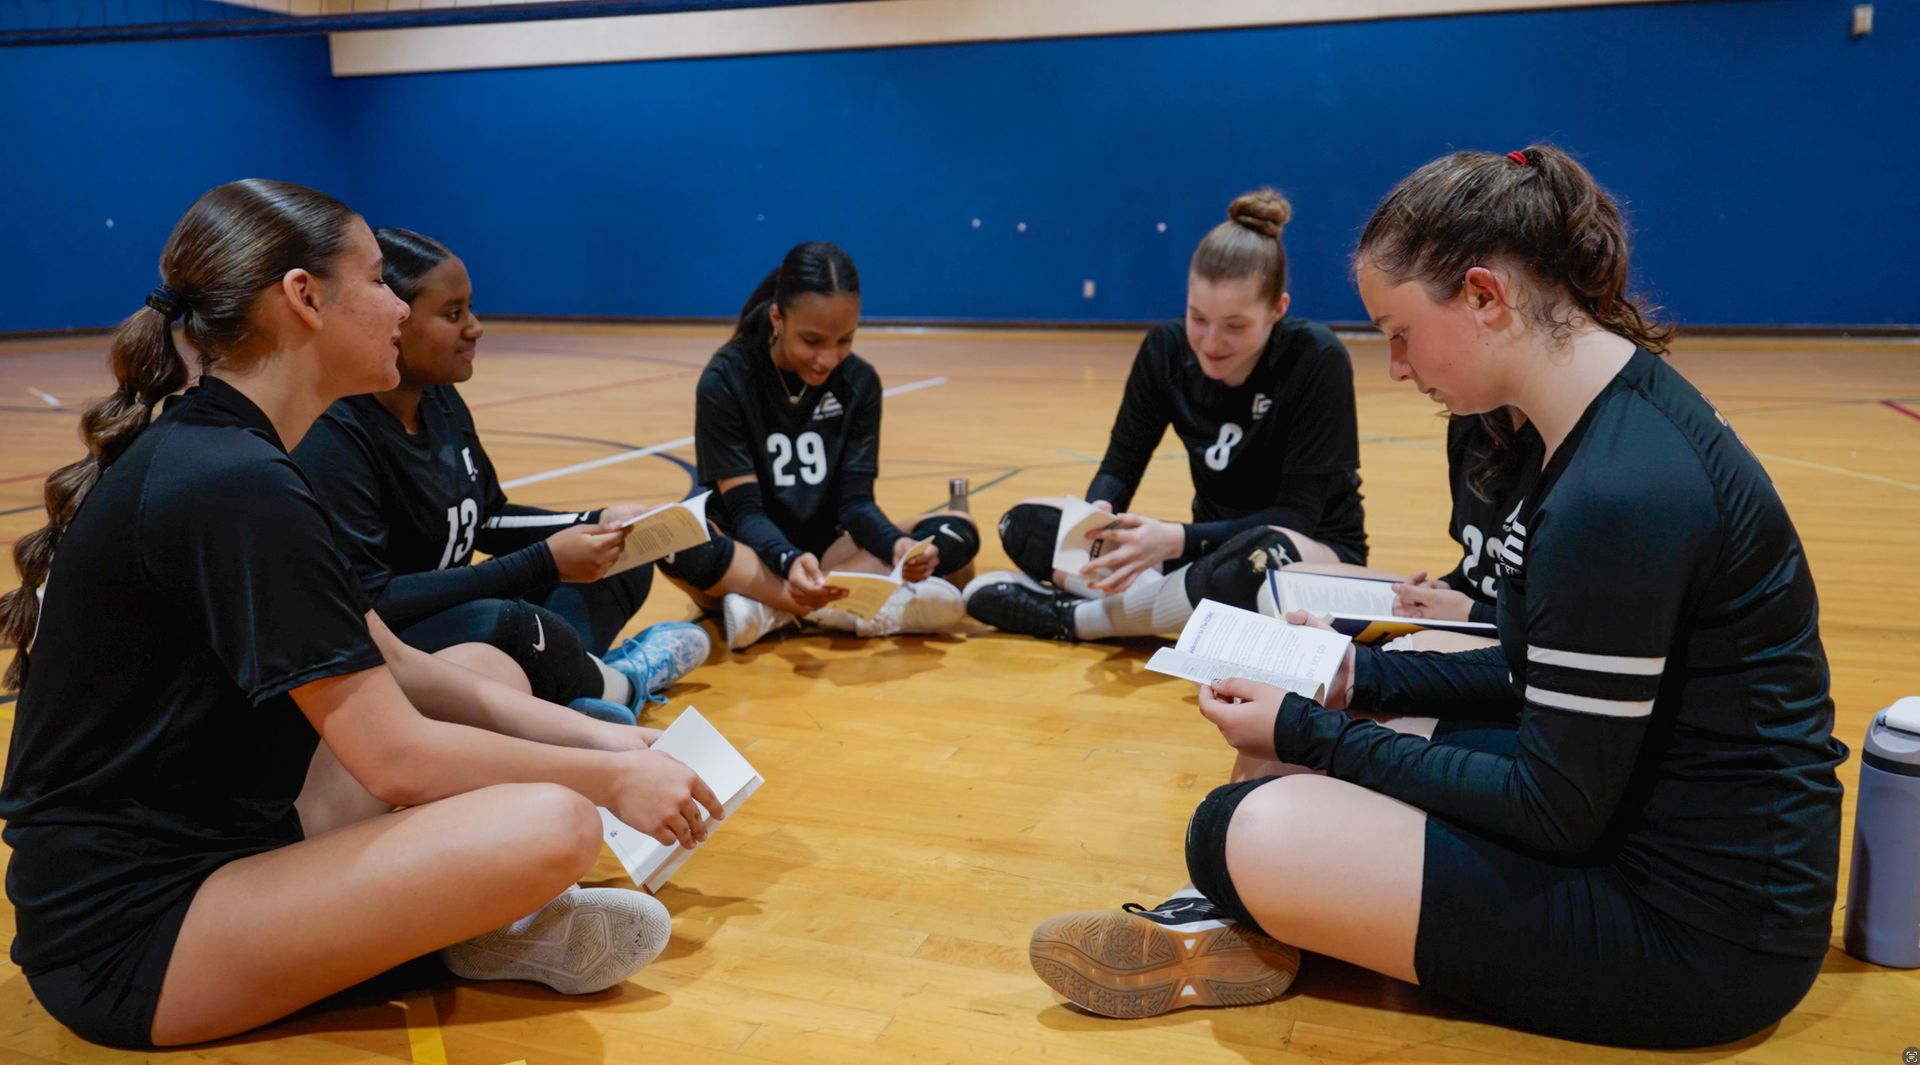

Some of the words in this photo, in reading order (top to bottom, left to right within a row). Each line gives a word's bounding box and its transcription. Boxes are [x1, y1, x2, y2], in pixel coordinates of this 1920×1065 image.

[766, 431, 828, 487] 29
[1205, 422, 1244, 472] 8
[438, 498, 478, 570] 13
